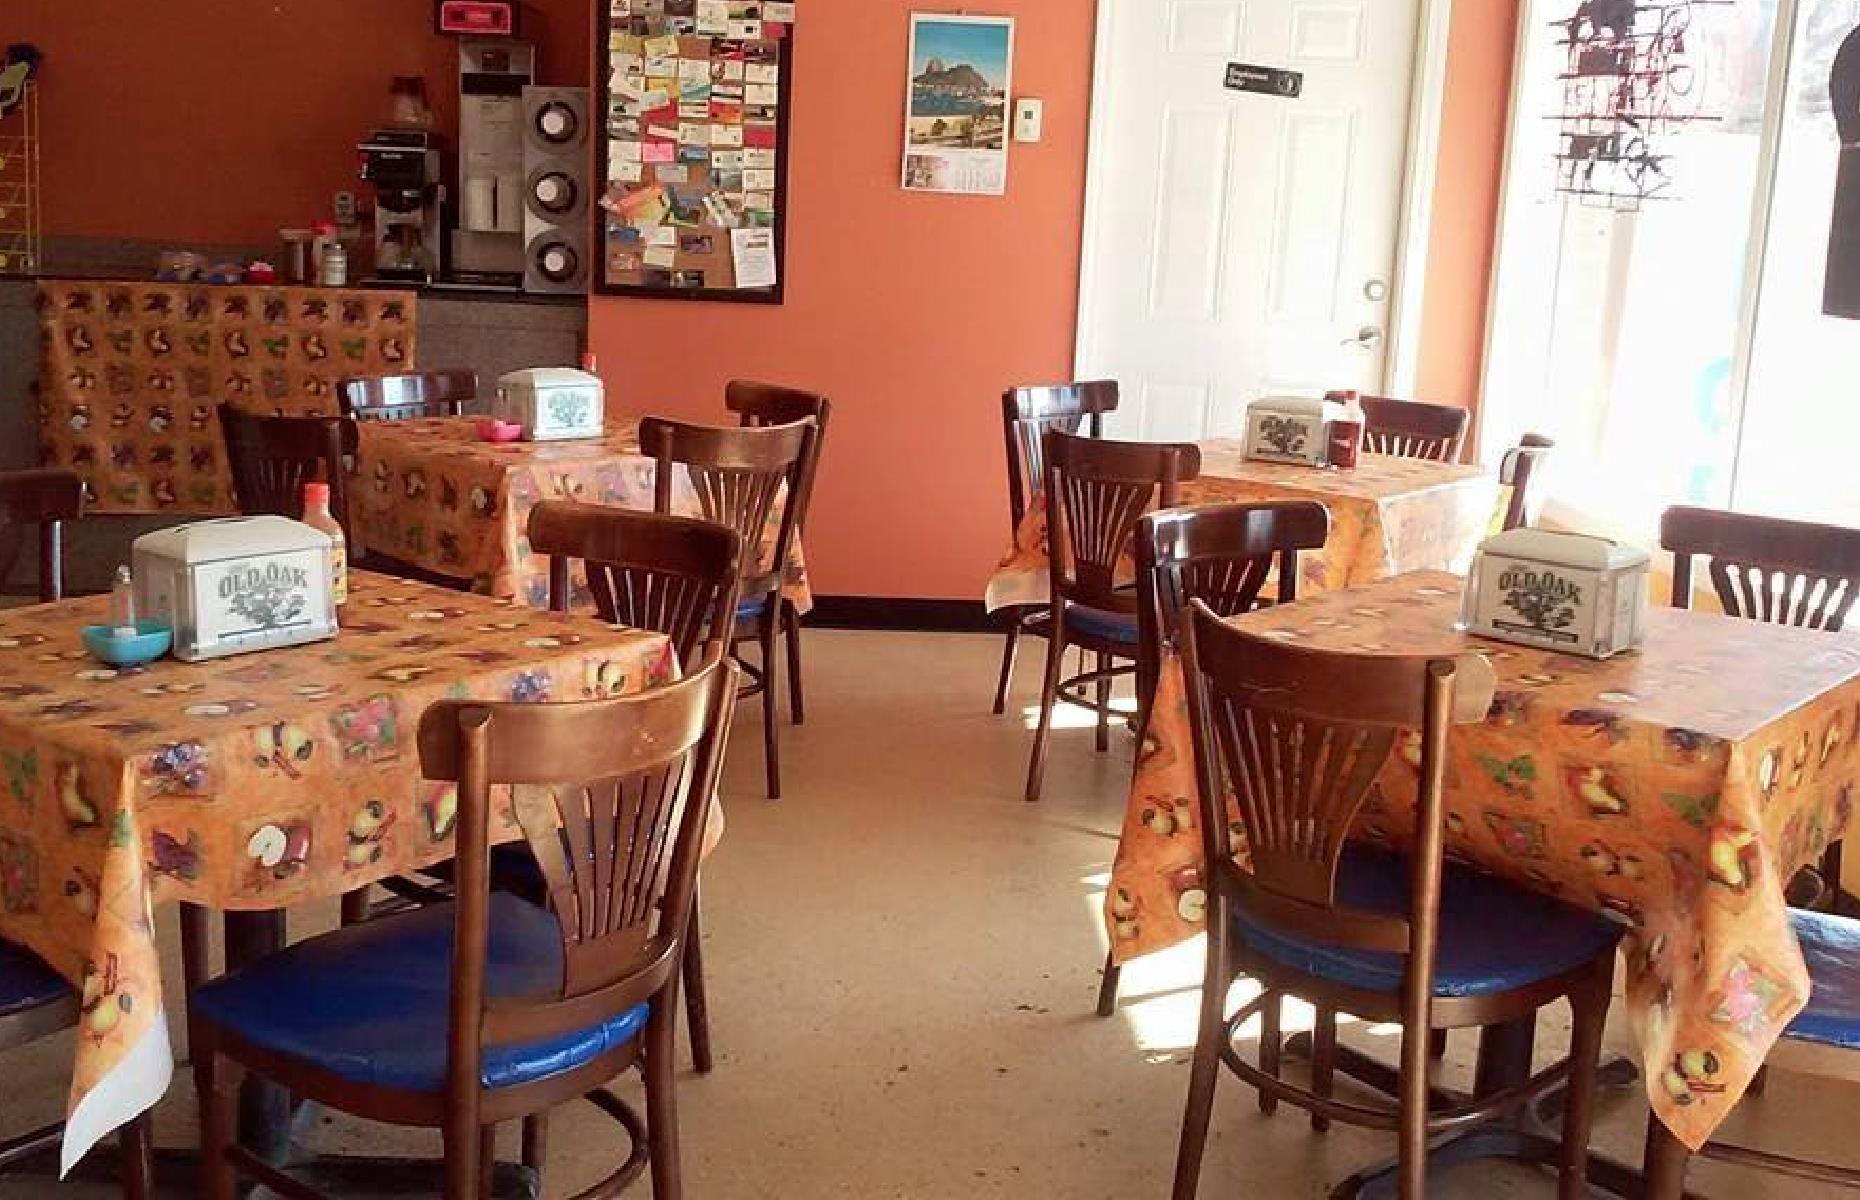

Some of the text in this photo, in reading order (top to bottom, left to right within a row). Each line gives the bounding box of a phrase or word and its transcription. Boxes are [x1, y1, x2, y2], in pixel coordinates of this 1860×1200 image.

[218, 562, 308, 598] OLD OAK
[1498, 571, 1581, 605] OLD OAK
